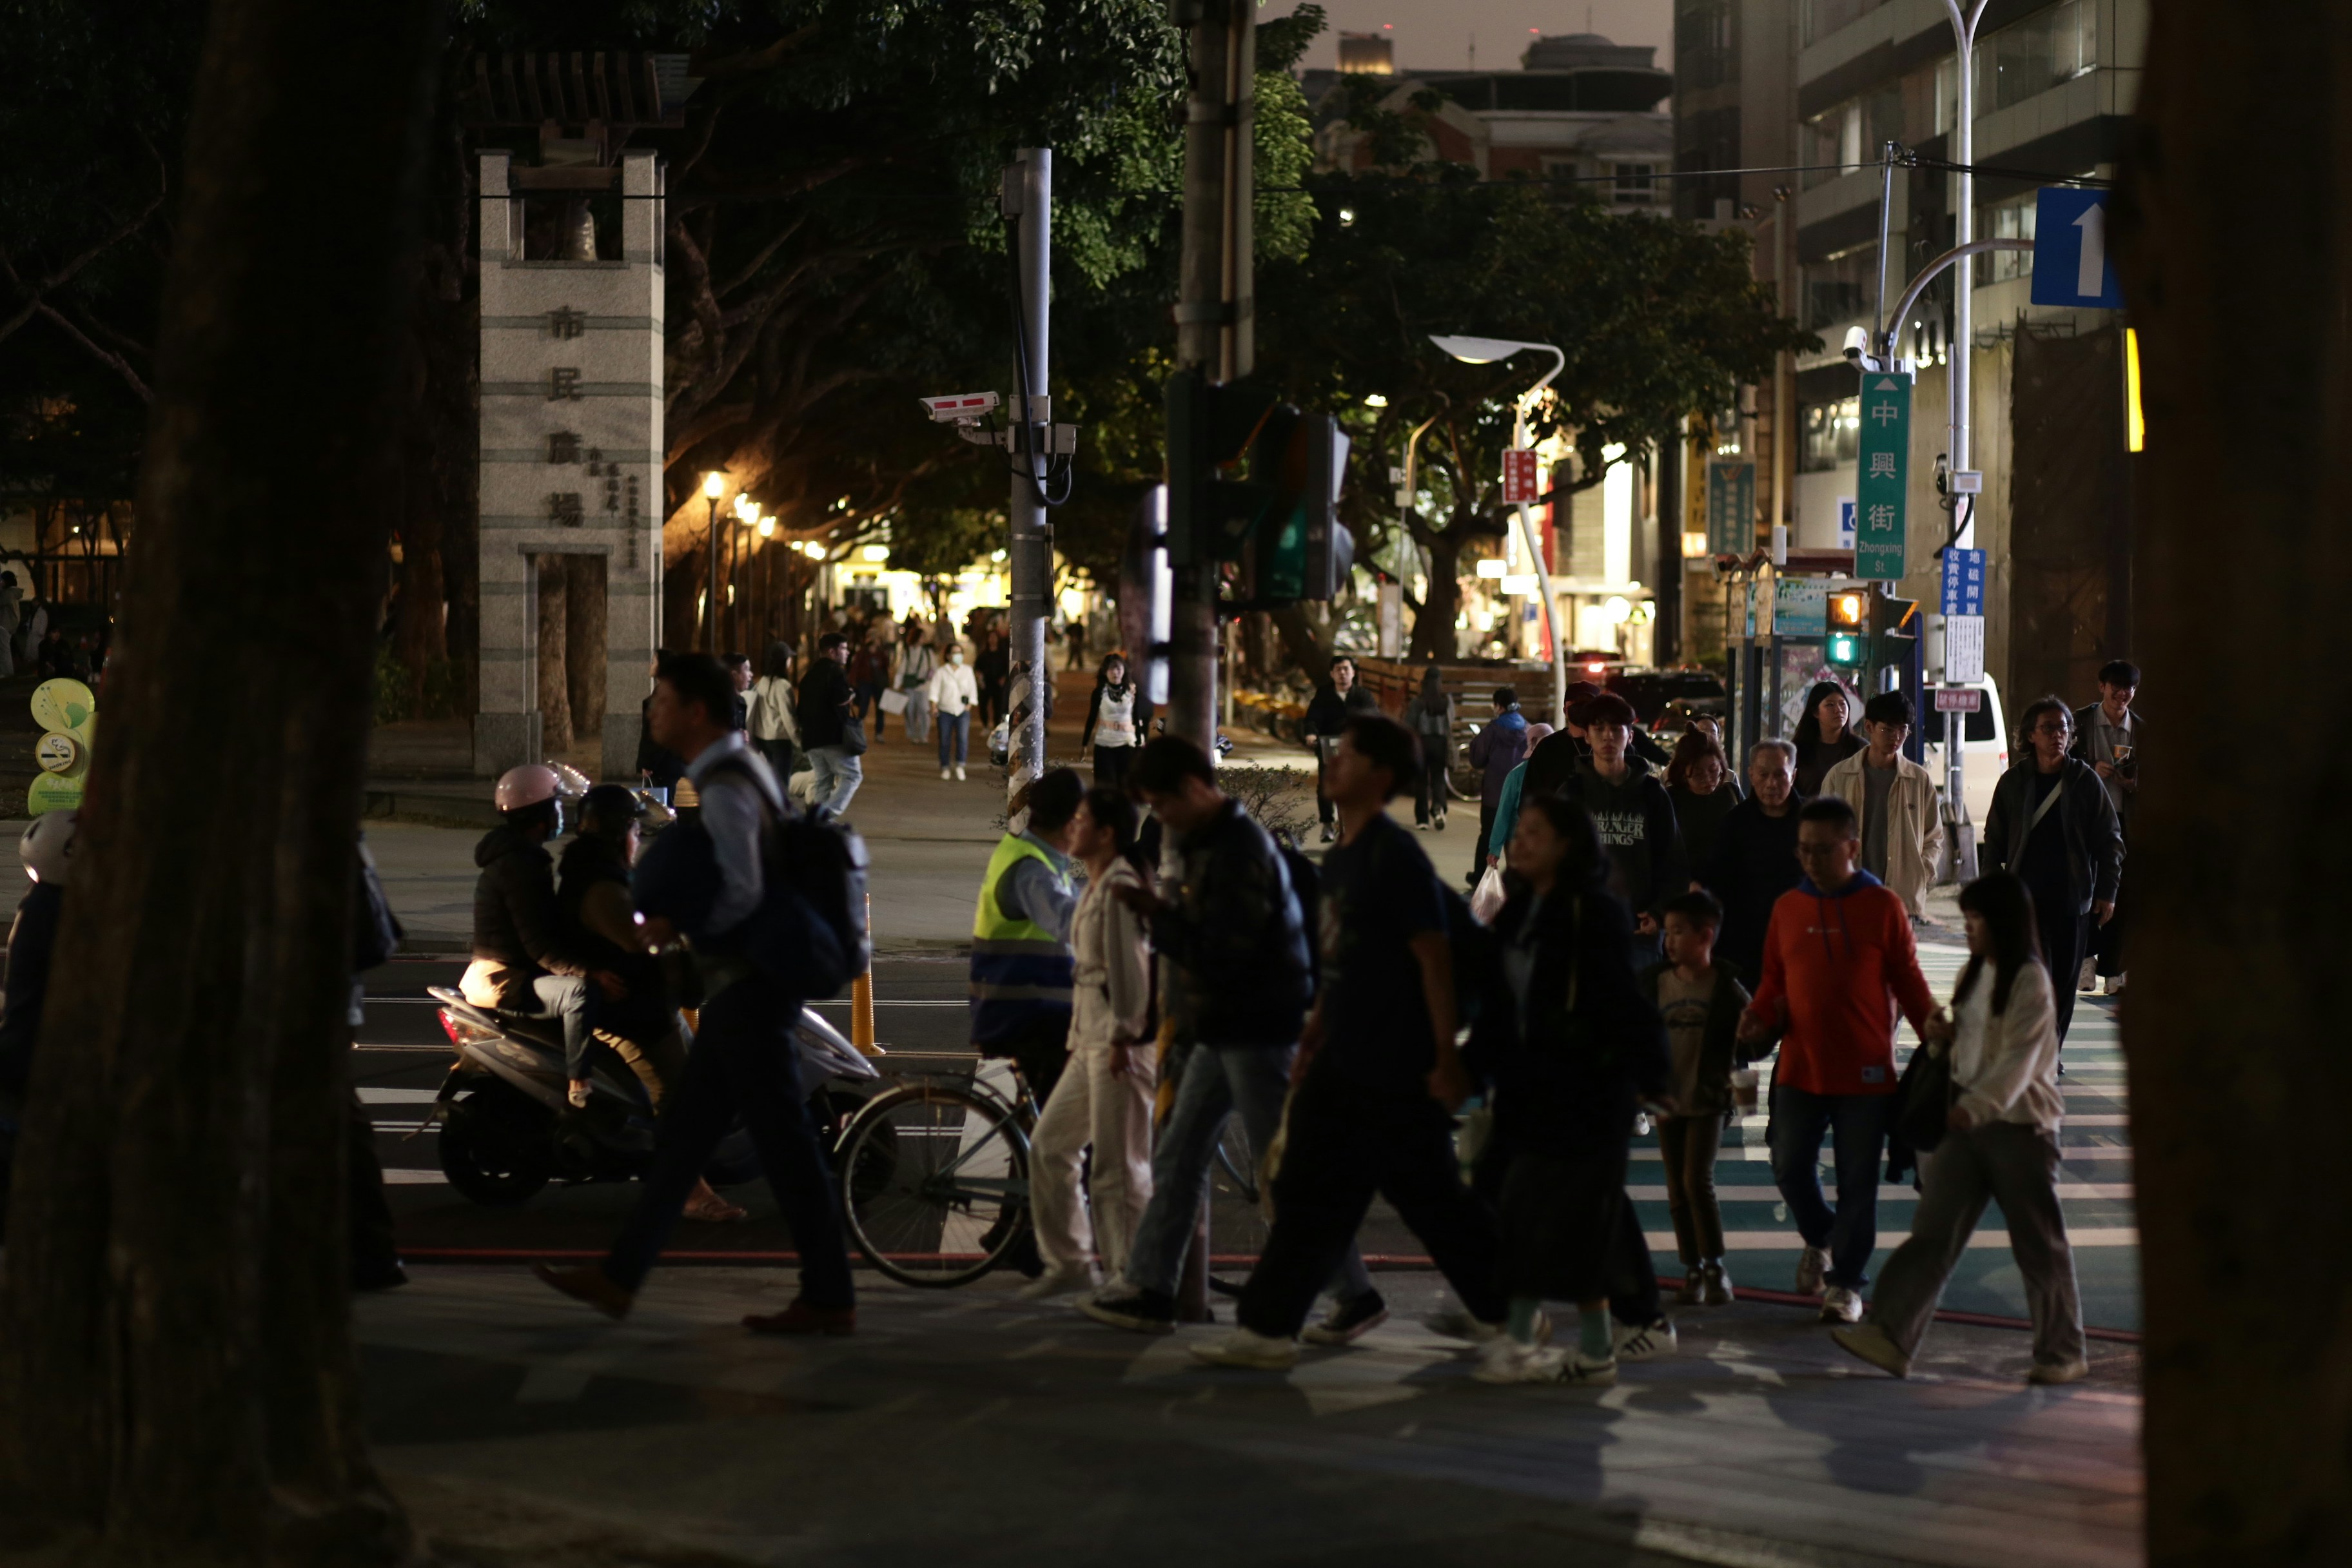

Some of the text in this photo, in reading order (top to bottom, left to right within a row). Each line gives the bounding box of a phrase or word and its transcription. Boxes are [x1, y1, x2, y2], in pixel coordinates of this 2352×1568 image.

[547, 305, 585, 527] 市民廣場
[1868, 400, 1898, 532] 中興街
[1858, 540, 1903, 556] Zhongxing
[1874, 560, 1886, 573] St.
[1966, 551, 1981, 615] 地磁開單
[48, 760, 72, 770] SMOKING
[1592, 820, 1644, 838] RANGER
[1599, 833, 1634, 845] HINGS
